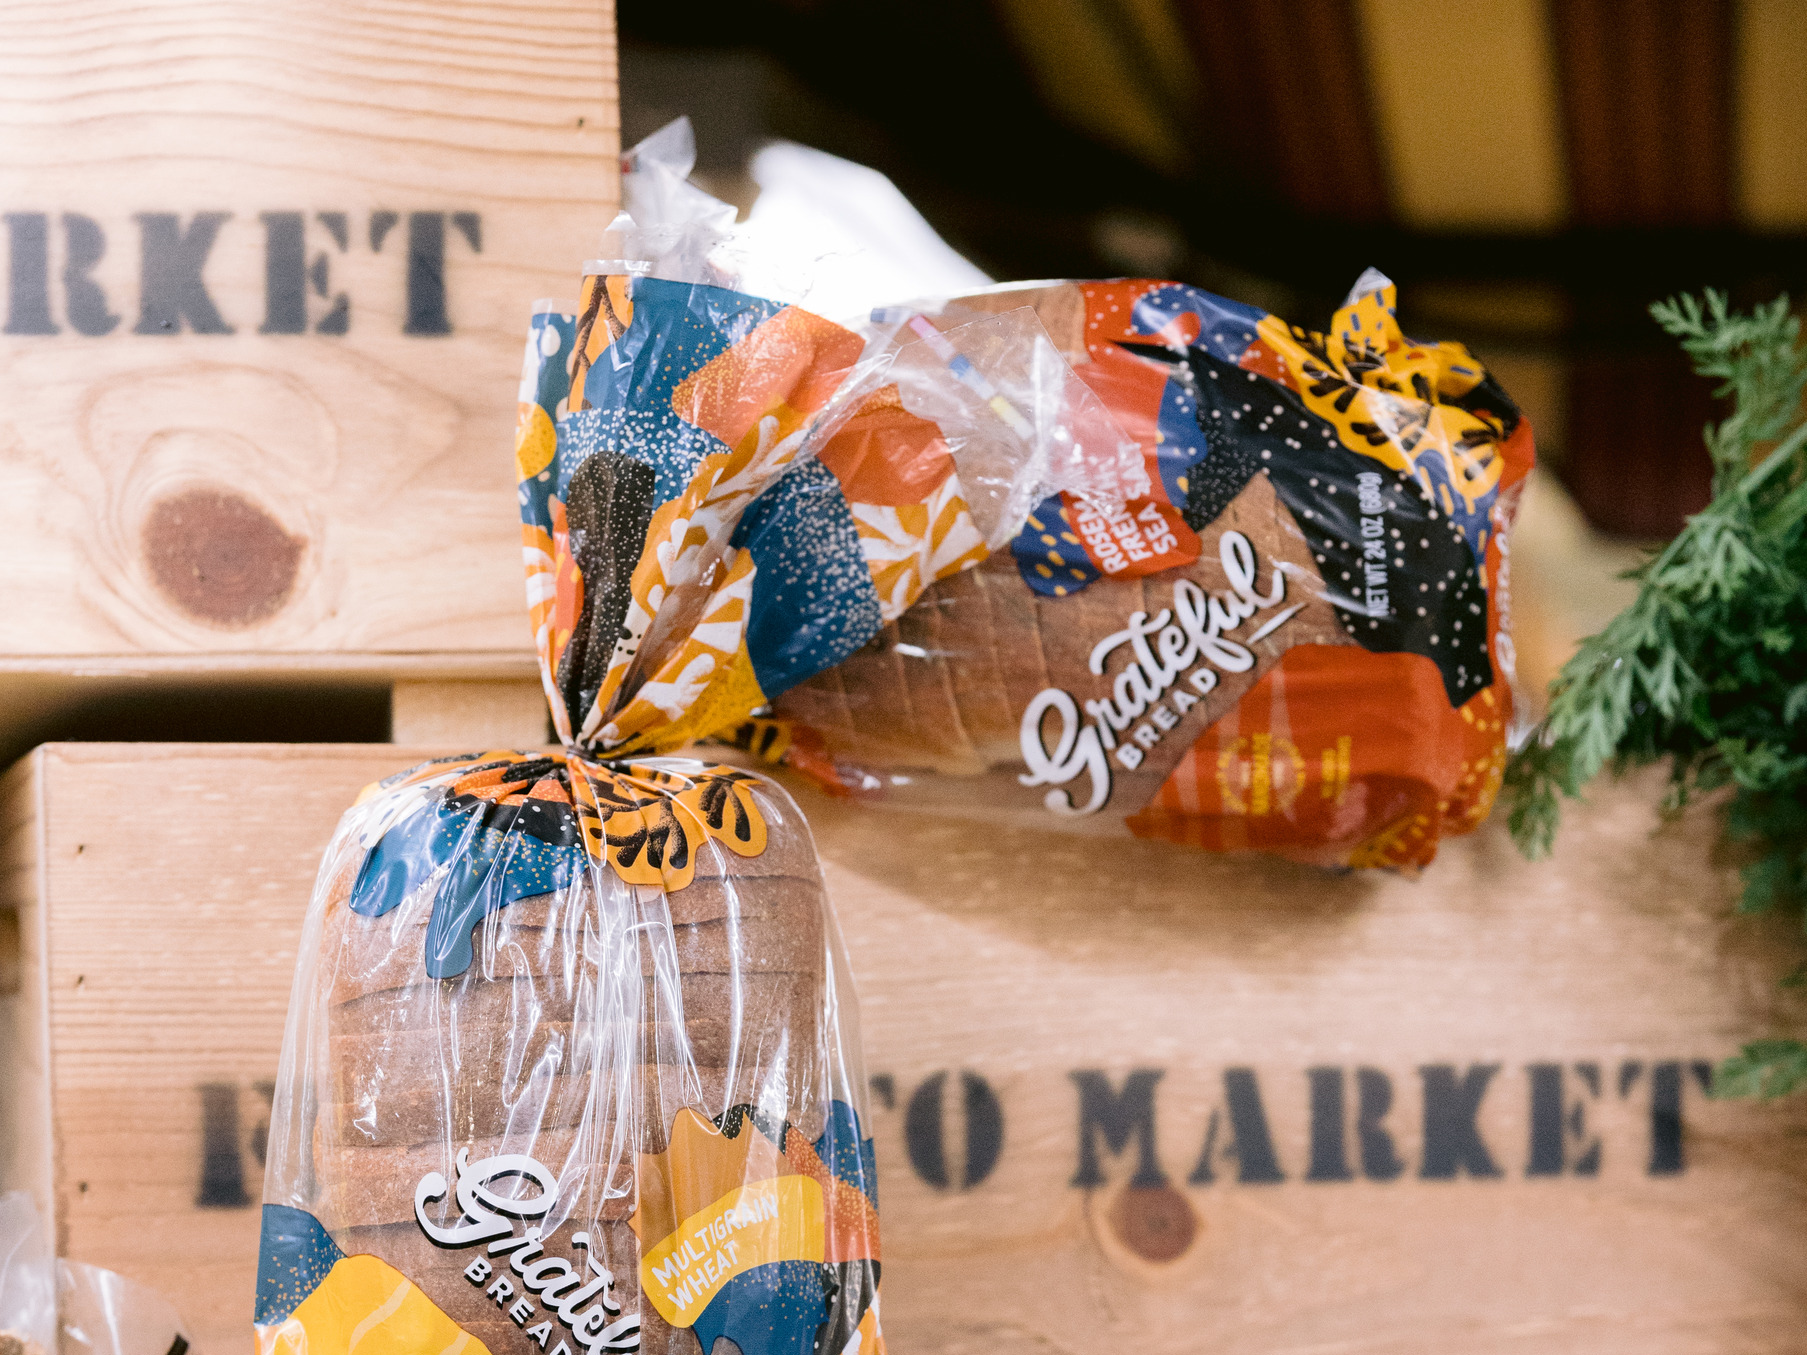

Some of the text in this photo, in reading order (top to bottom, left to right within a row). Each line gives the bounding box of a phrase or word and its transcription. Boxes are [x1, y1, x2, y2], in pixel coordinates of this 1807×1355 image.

[1137, 501, 1178, 555] SEA
[1360, 515, 1385, 538] OZ
[1363, 538, 1387, 560] 24
[1363, 562, 1389, 587] WT
[1018, 530, 1287, 815] Grateful
[1116, 667, 1219, 771] BREAD
[1068, 1060, 1714, 1188] MARKET
[651, 1194, 779, 1288] MULTIGRAIN
[667, 1240, 739, 1311] WHEAT
